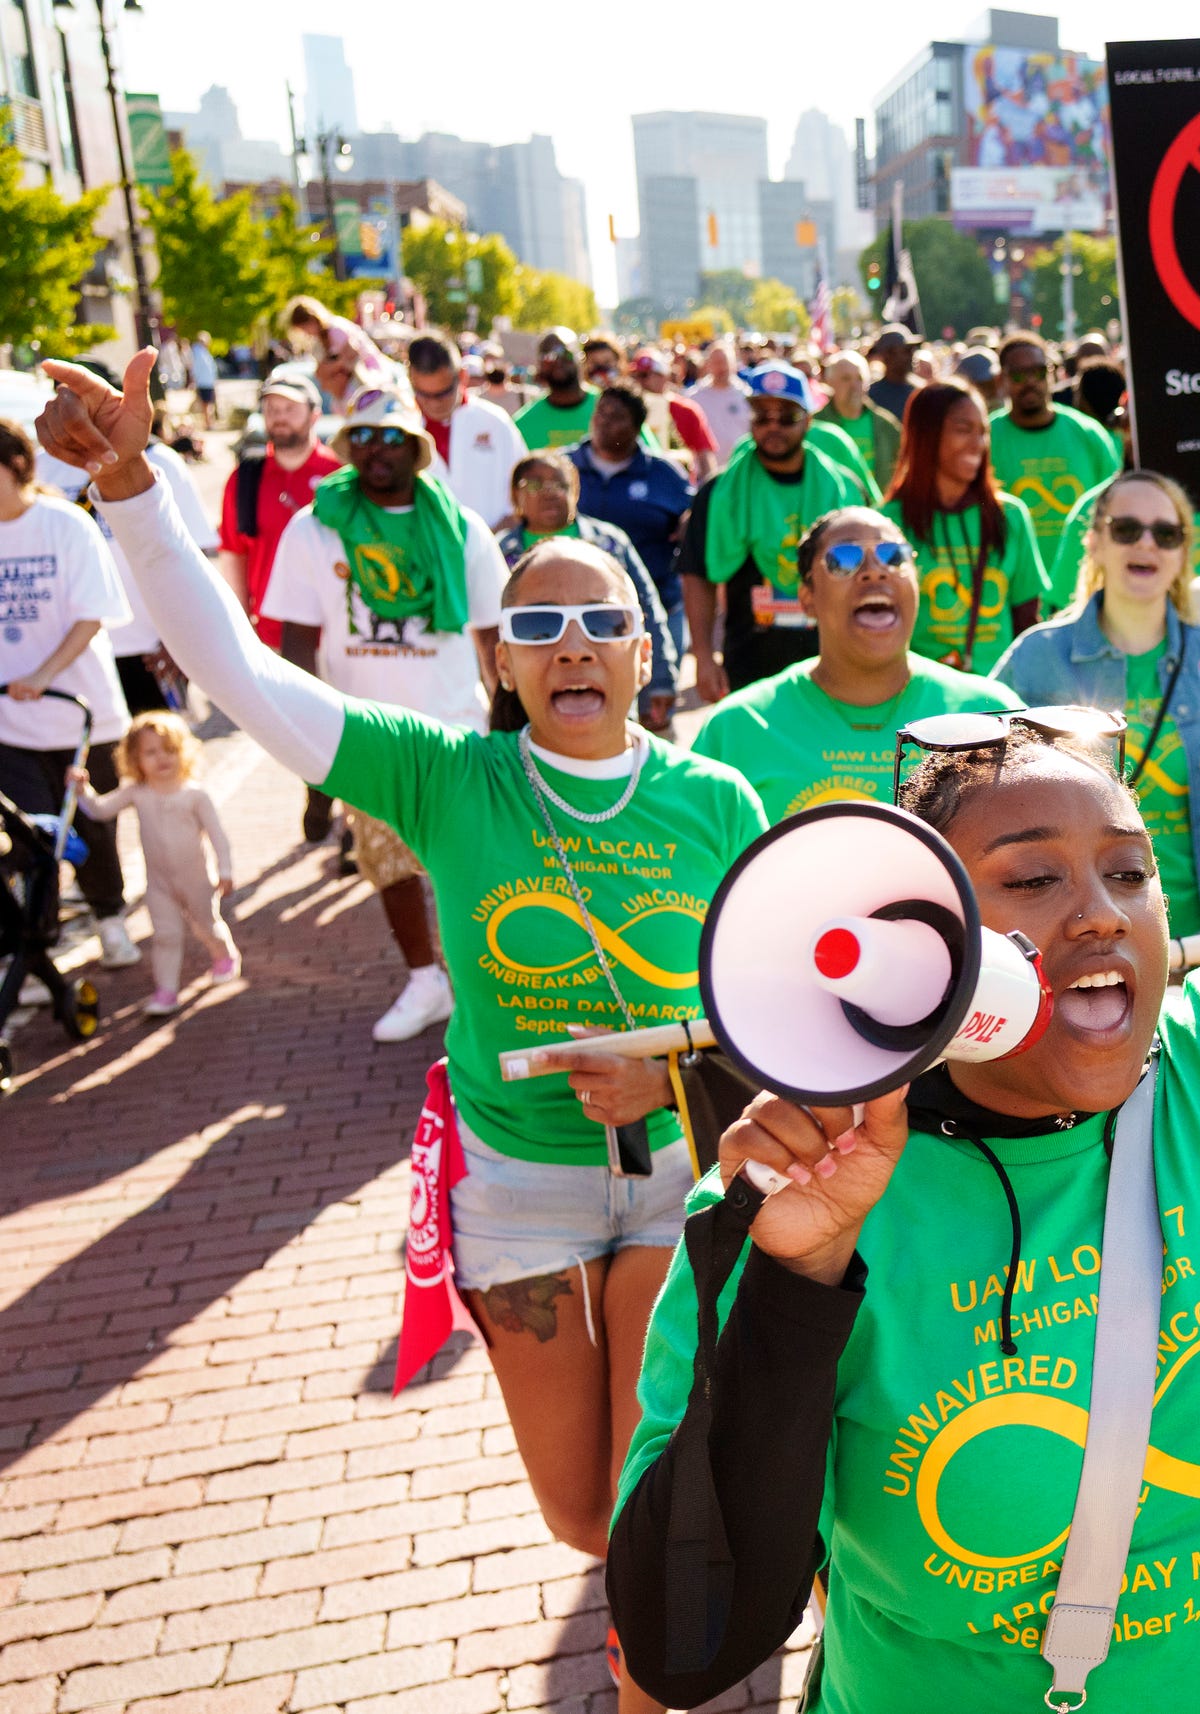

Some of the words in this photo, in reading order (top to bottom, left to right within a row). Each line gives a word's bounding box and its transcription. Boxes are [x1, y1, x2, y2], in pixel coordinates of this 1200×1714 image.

[822, 750, 866, 763] UAW
[587, 836, 661, 860] LOCAL
[664, 843, 677, 860] 7
[623, 862, 672, 880] LABOR
[497, 994, 570, 1011] LABOR
[577, 1000, 621, 1014] DAY
[626, 1002, 701, 1021] MARCH
[950, 1259, 1037, 1313] UAW
[1164, 1205, 1185, 1238] 7
[883, 1355, 1078, 1496] UNWAVERED
[1119, 1557, 1178, 1595] AY
